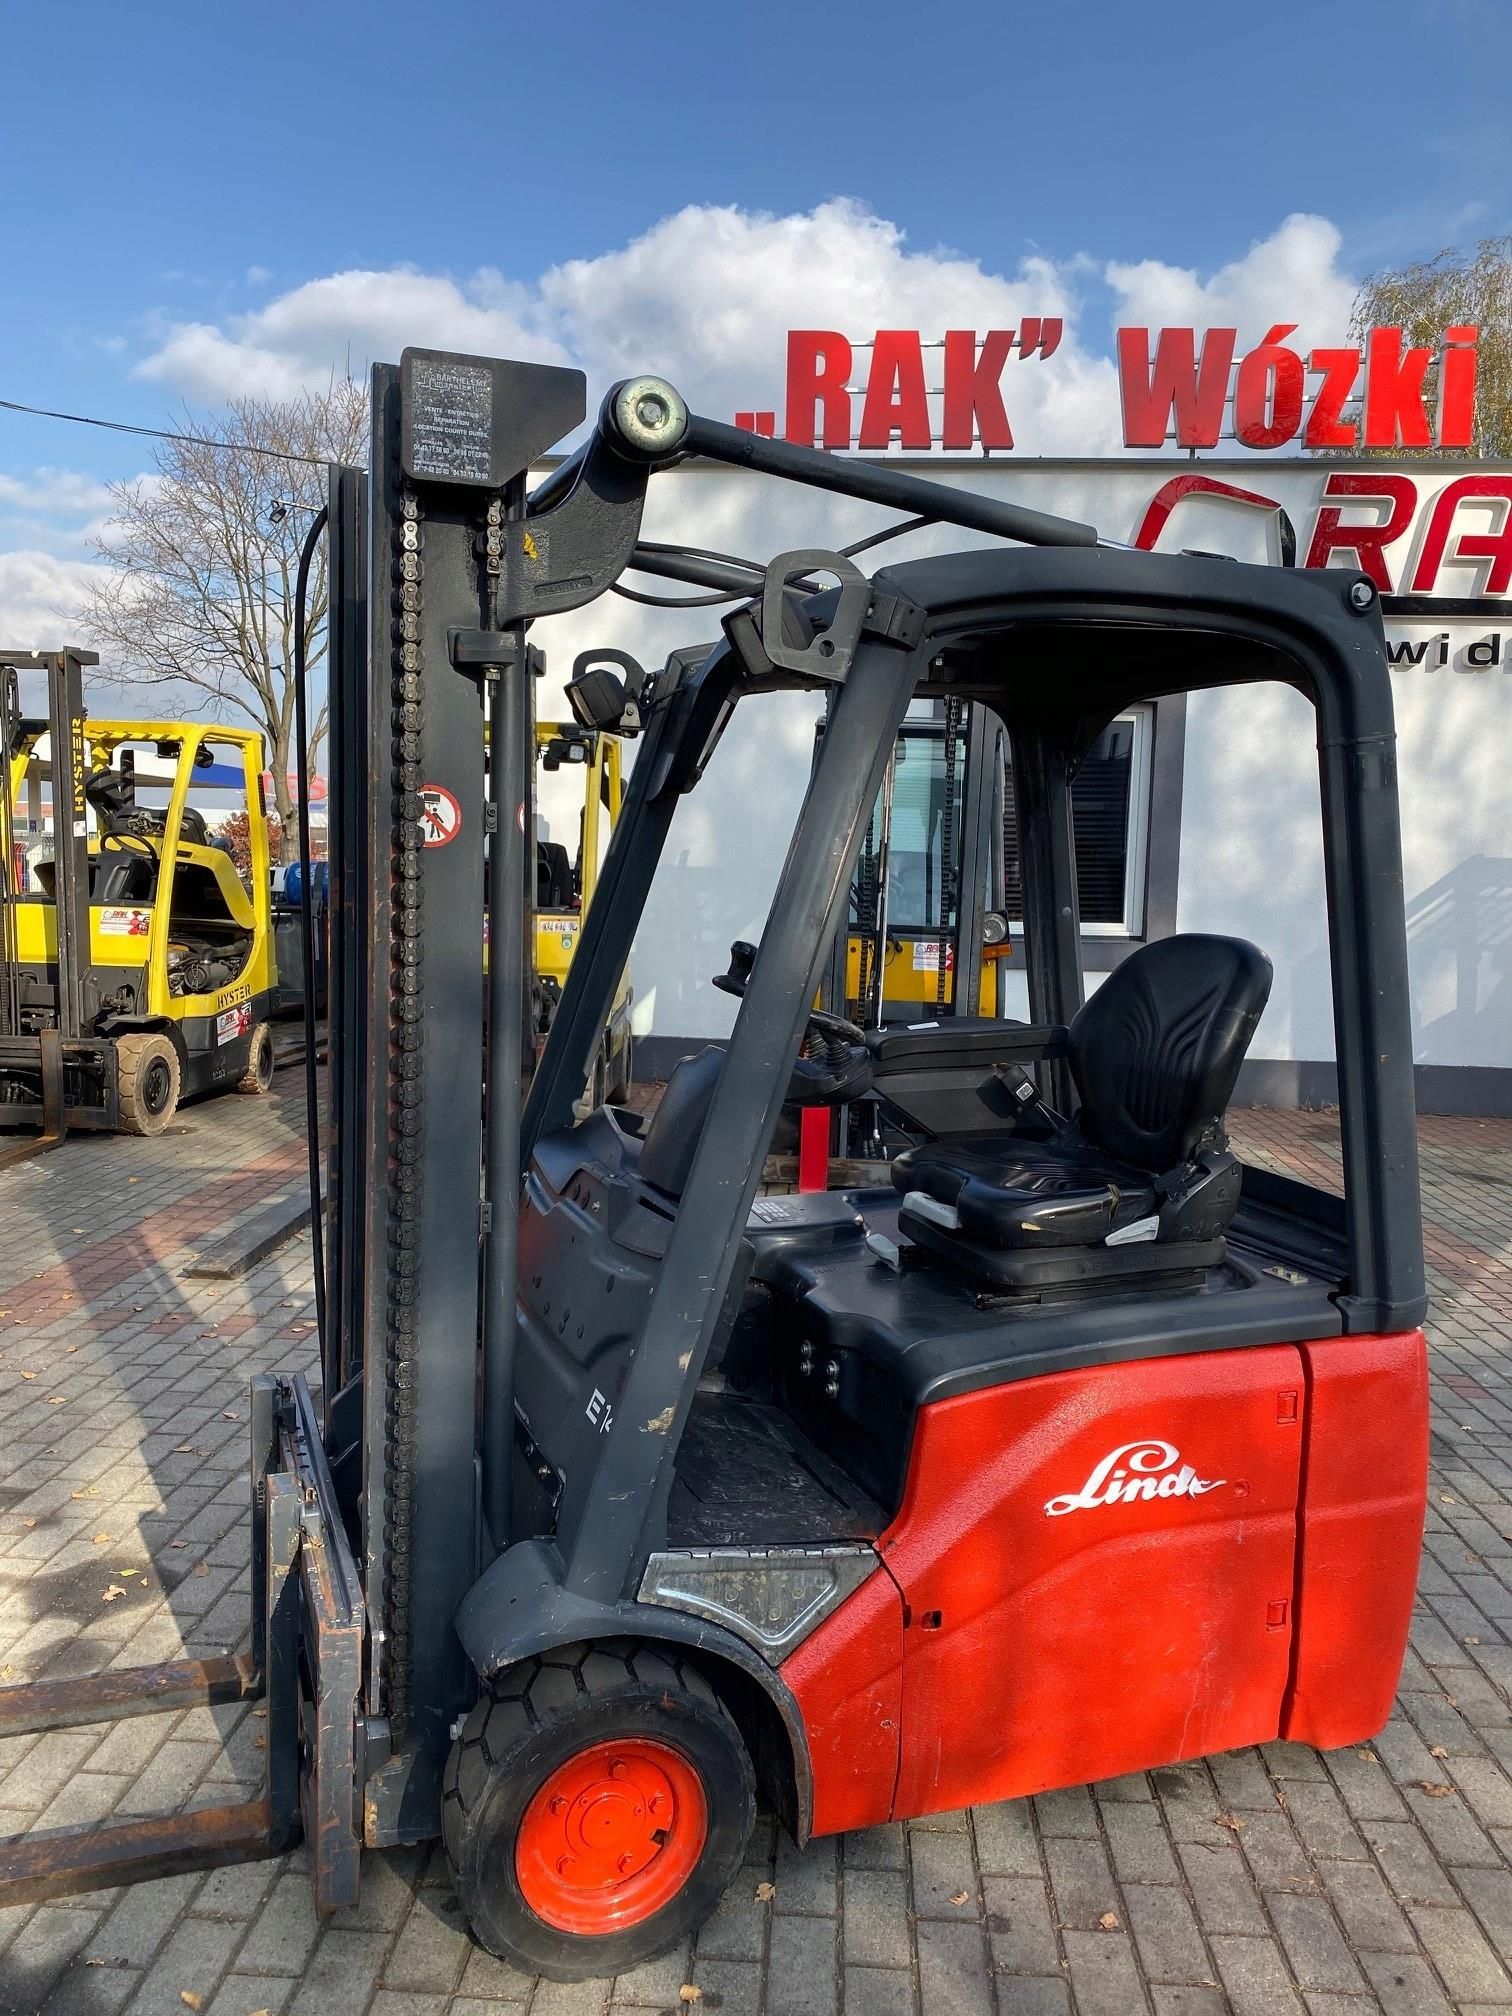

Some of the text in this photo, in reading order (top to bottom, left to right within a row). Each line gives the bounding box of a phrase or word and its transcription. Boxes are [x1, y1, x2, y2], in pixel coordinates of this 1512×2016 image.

[1117, 324, 1478, 449] Wózki
[72, 718, 84, 812] HYSTER
[217, 983, 252, 1010] HYSTER
